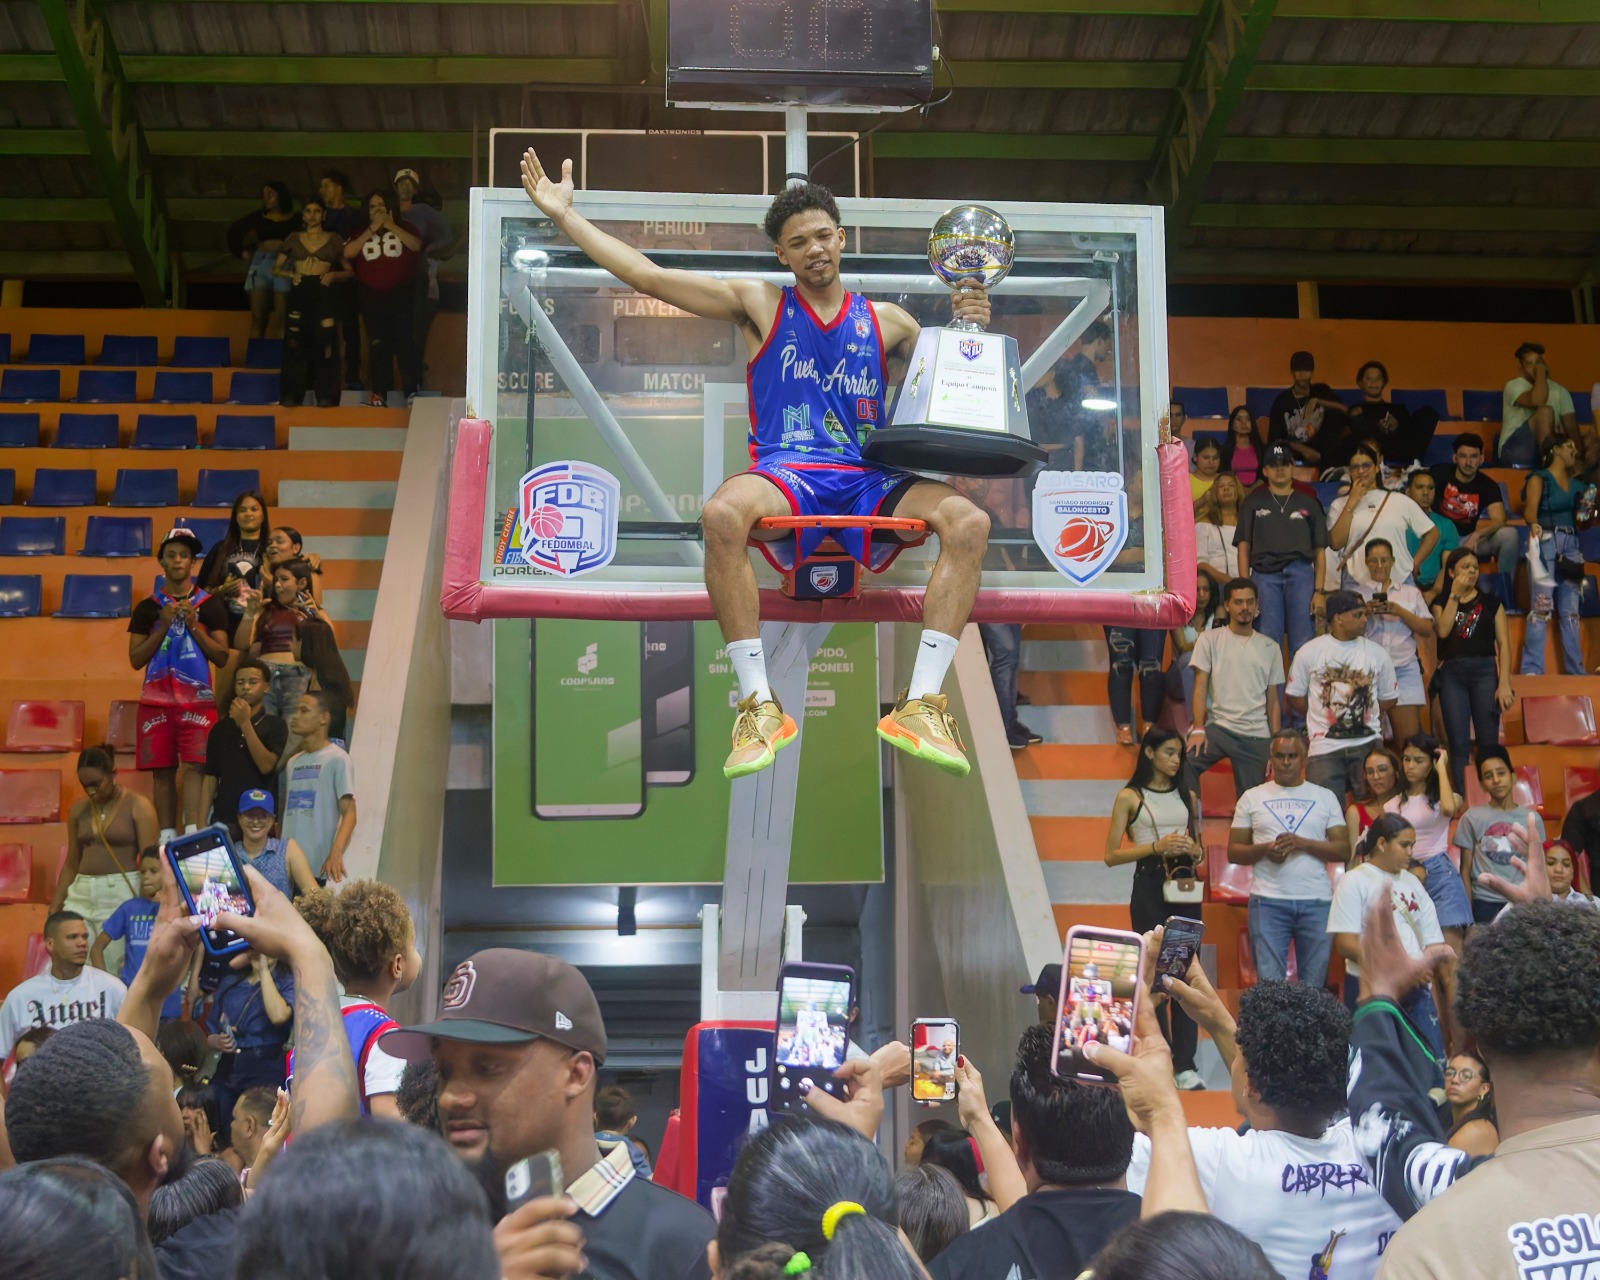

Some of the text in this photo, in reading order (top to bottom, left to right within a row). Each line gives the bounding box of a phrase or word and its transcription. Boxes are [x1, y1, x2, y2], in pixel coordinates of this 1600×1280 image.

[643, 220, 706, 235] PERIOD
[643, 372, 706, 390] MATCH
[822, 358, 879, 397] Arriba
[535, 484, 605, 510] FDB
[1057, 506, 1107, 514] BALONCESTO
[495, 539, 506, 564] STUDY
[541, 539, 596, 550] FEDOMBAL
[816, 647, 847, 660] PIDO,
[708, 663, 728, 674] SIN
[1271, 801, 1308, 810] GUESS
[745, 1047, 770, 1136] JUA
[1512, 1216, 1600, 1262] 369L
